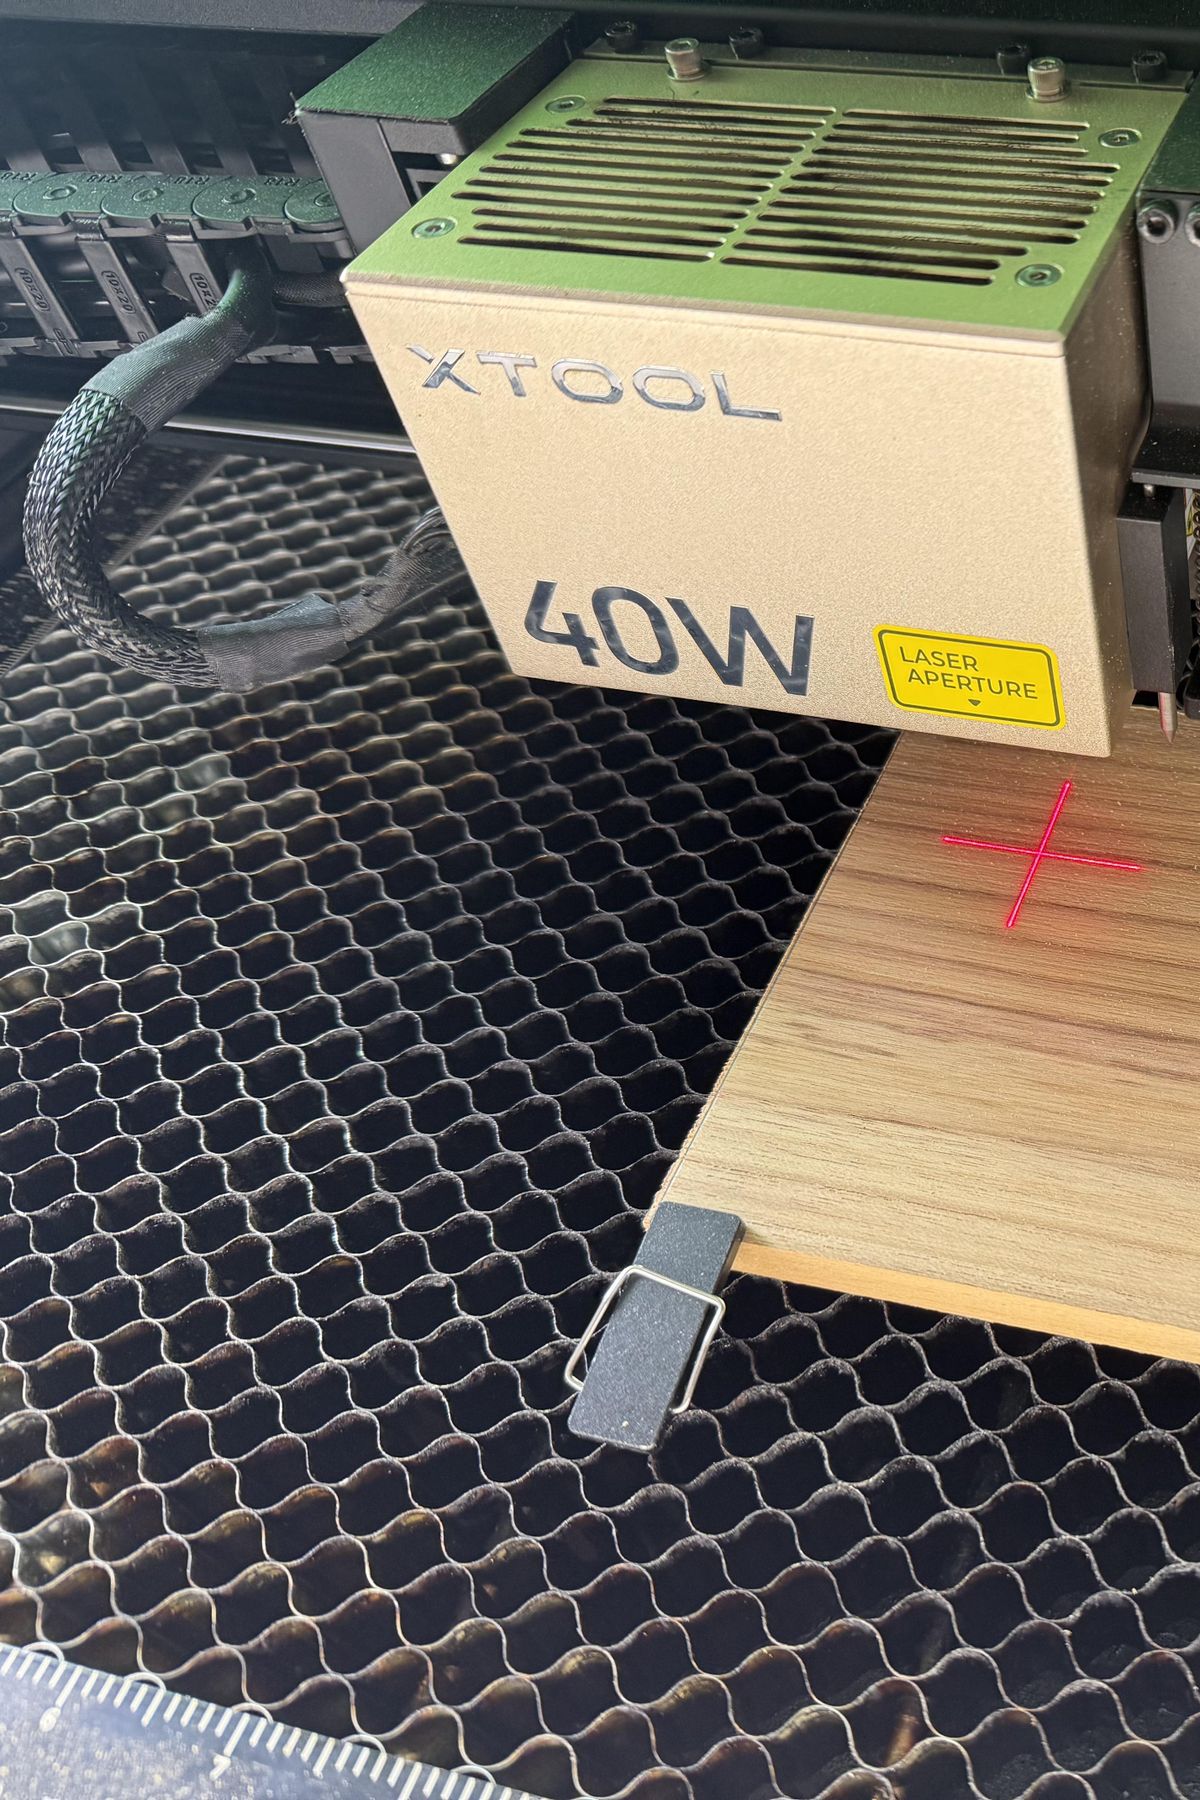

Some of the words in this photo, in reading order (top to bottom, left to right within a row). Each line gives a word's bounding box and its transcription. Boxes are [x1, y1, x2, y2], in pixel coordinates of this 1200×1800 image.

[405, 343, 783, 422] XTOOL
[523, 579, 815, 697] 40W
[899, 645, 979, 672] LASER
[907, 668, 1039, 700] APERTURE
